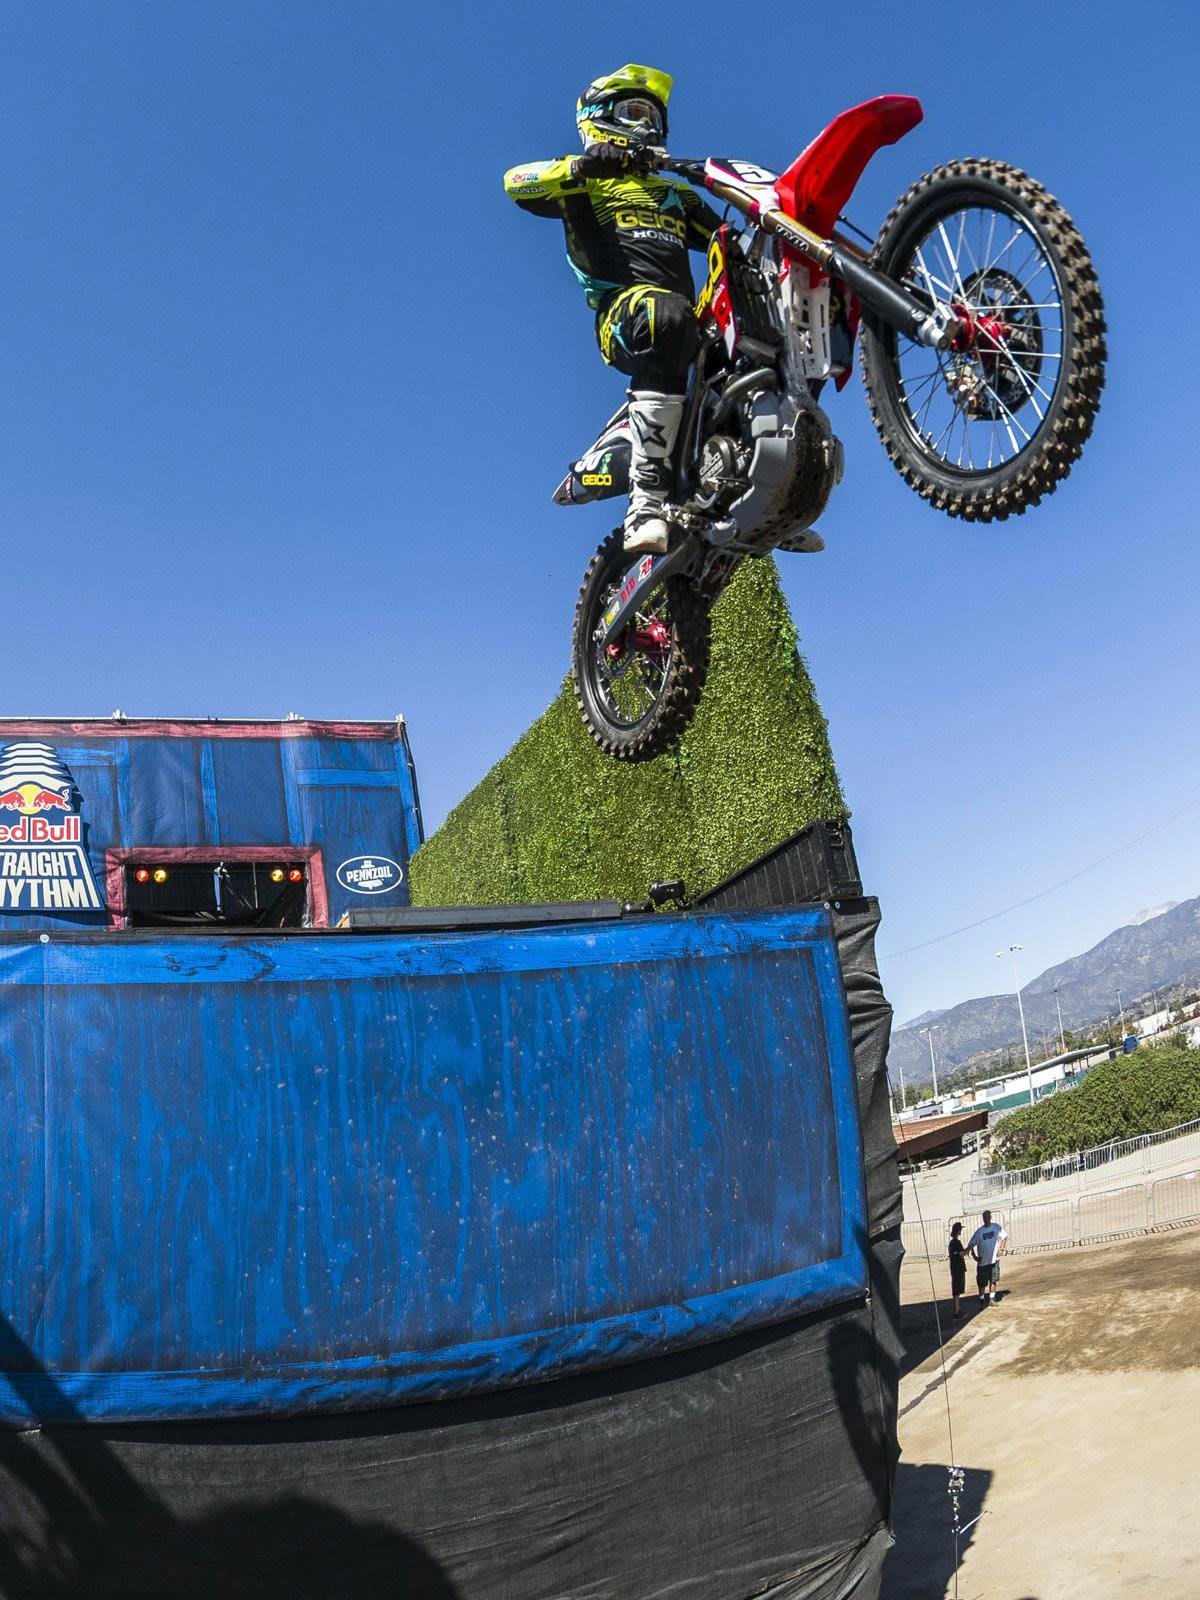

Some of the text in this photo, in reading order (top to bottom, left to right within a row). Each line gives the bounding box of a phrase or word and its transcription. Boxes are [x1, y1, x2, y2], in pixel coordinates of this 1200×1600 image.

[615, 209, 686, 239] GEICO
[632, 230, 685, 249] HONDA
[582, 474, 612, 486] GEICO
[30, 816, 81, 842] Bull
[346, 865, 393, 883] PENNZOIL
